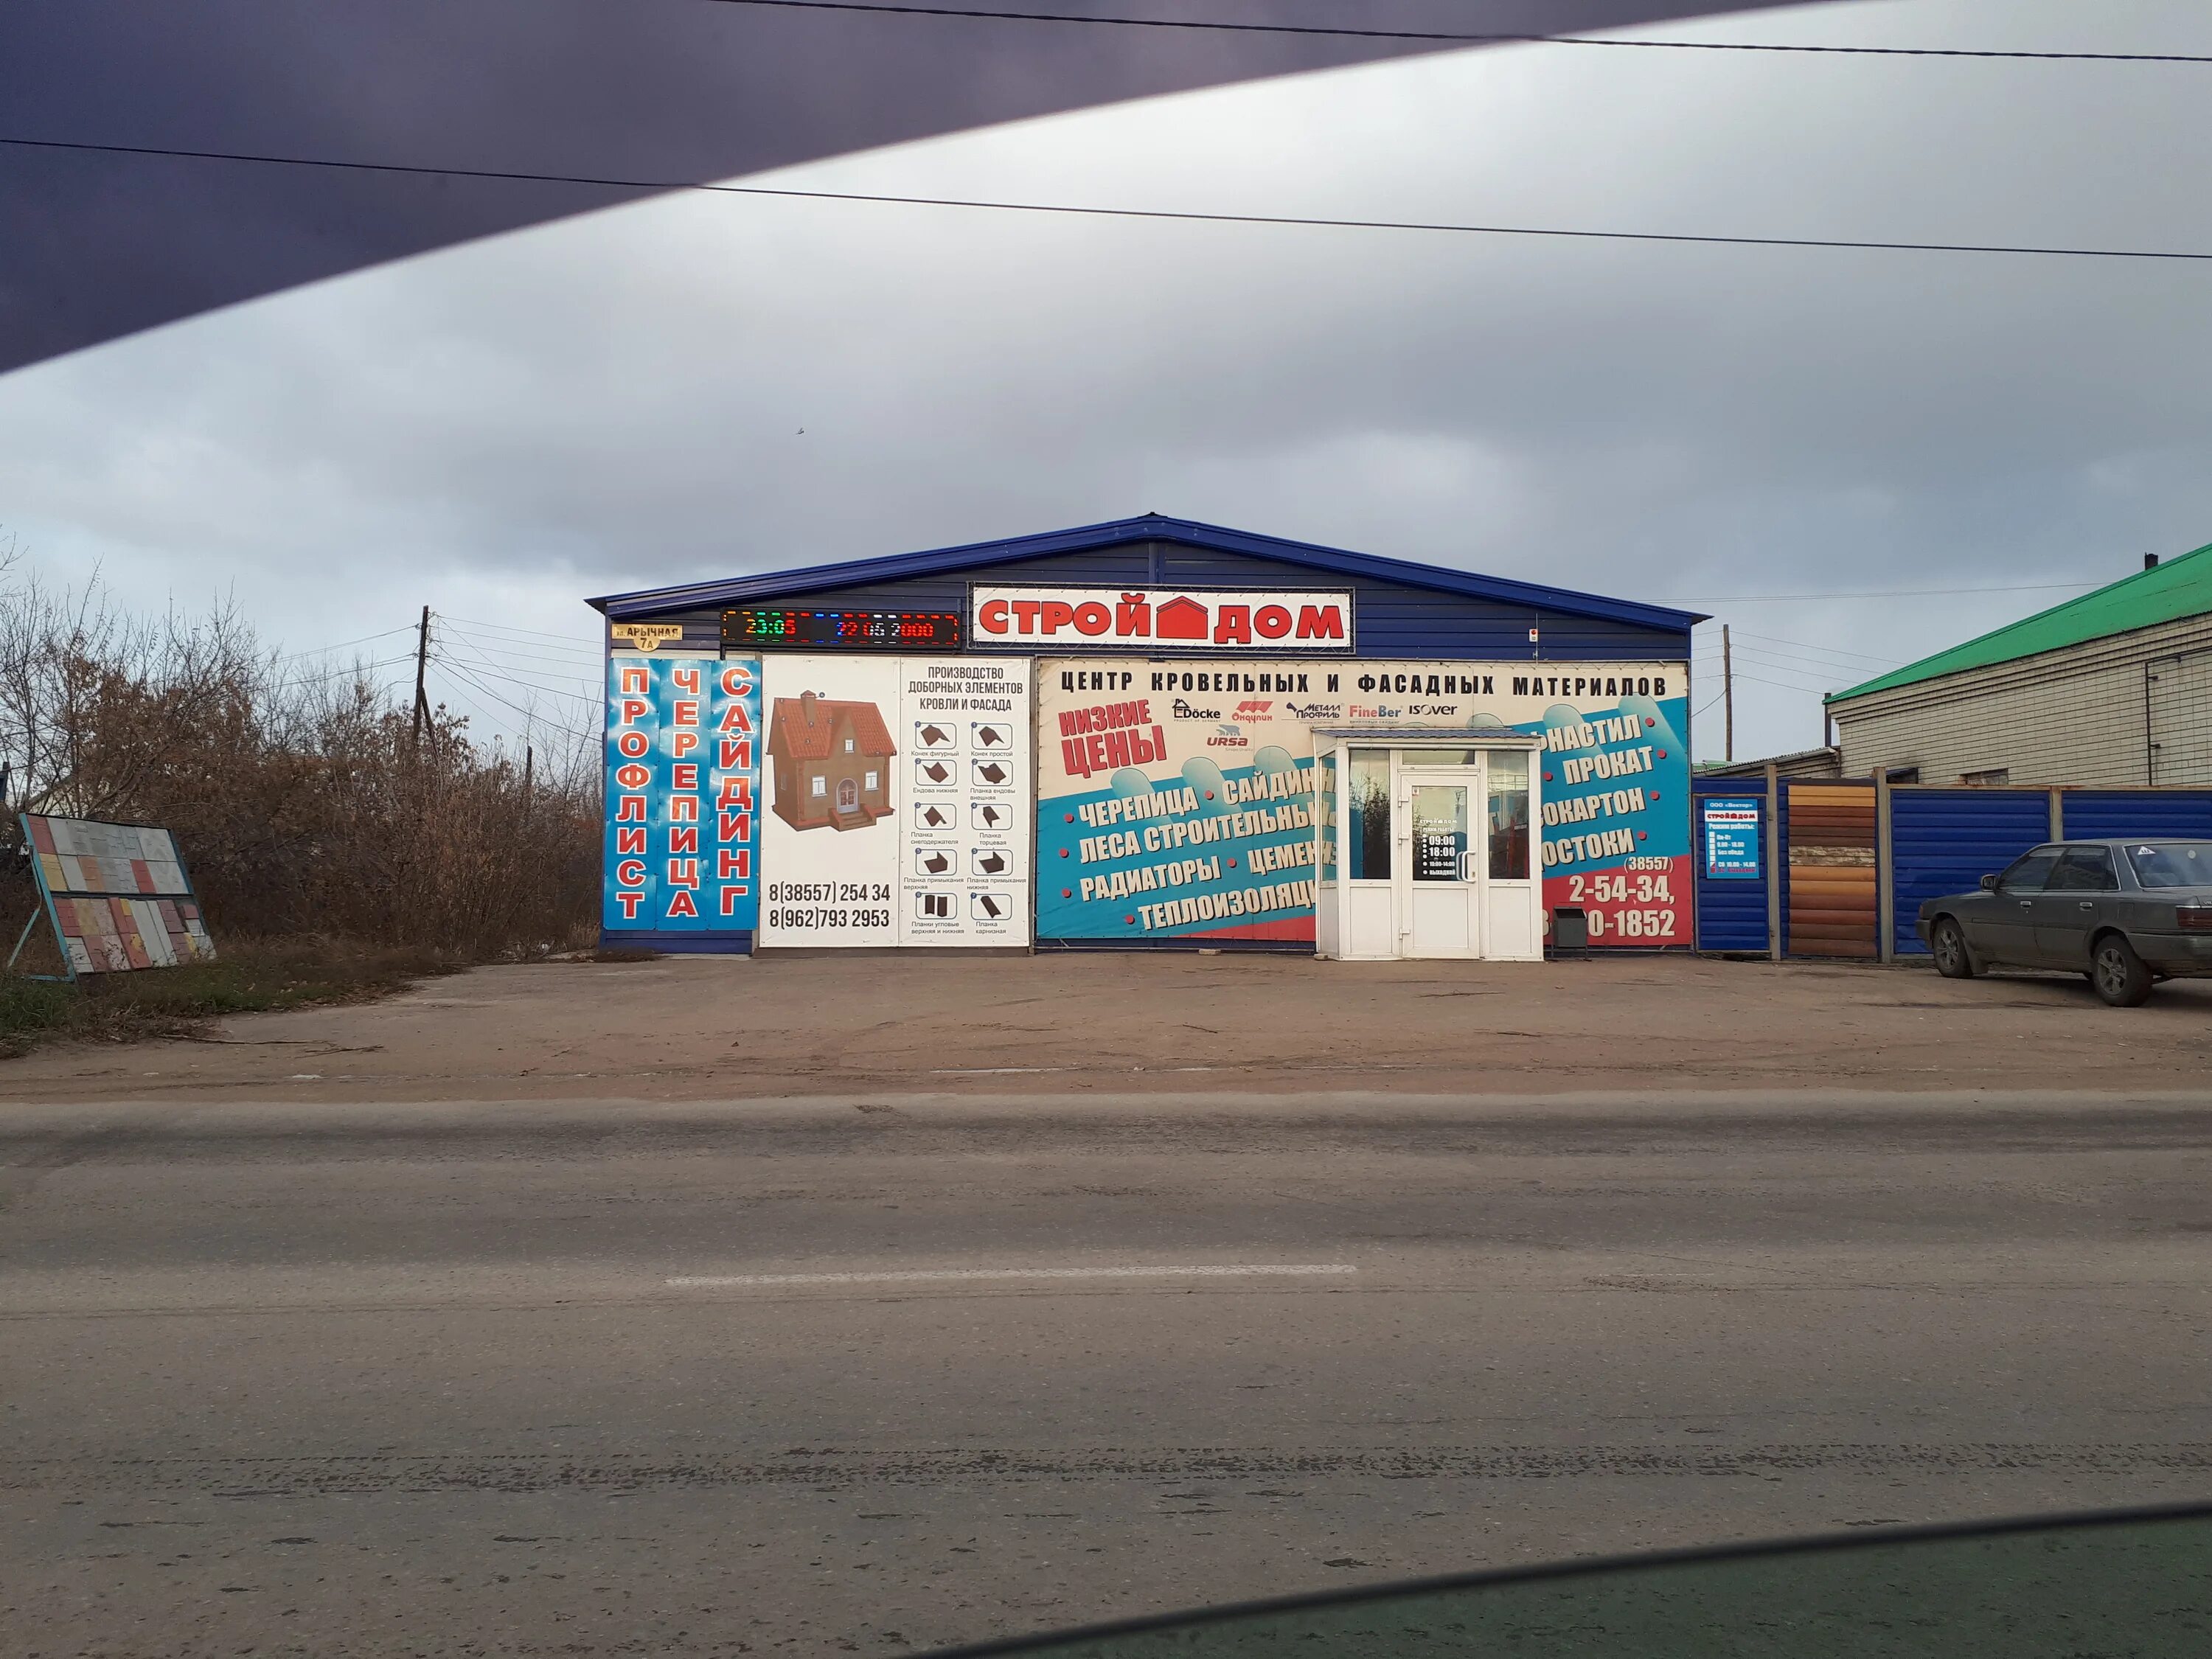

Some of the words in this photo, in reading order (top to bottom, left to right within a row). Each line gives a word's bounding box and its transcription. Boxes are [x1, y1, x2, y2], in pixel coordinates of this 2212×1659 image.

[627, 627, 678, 637] АРЫЧНАЯ
[745, 619, 796, 635] 23:05
[978, 592, 1152, 636] СТРОЙ
[1214, 604, 1344, 644] ДОМ
[640, 637, 653, 649] 7А
[908, 681, 963, 694] ДОБОРНЫХ
[964, 682, 1023, 695] ЭЛЕМЕНТОВ
[928, 666, 1004, 681] ПРОИЗВОДСТВО
[1062, 671, 1133, 693] ЦЕНТР
[1151, 672, 1310, 693] КРОВЕЛЬНЫХ
[1327, 673, 1339, 692] И
[1357, 674, 1494, 698] ФАСАДНЫХ
[1513, 677, 1666, 697] МАТЕРИАЛОВ
[919, 698, 959, 710] КРОВЛИ
[961, 698, 968, 710] И
[970, 698, 1012, 712] ФАСАДА
[1058, 699, 1152, 737] НИЗКИЕ
[1183, 708, 1221, 719] Döcke
[1349, 705, 1402, 718] FineBer
[1531, 714, 1643, 754] НАСТИЛ
[1061, 725, 1167, 779] ЦЕНЫ
[1562, 745, 1654, 785] ПРОКАТ
[615, 667, 651, 919] ПРОФЛИСТ
[666, 668, 700, 918] ЧЕРЕПИЦА
[715, 667, 755, 917] САЙДИНГ
[1078, 786, 1200, 828] ЧЕРЕПИЦА
[1221, 768, 1315, 805] САЙДИН
[1540, 787, 1646, 827] ОКАРТОН
[1079, 830, 1142, 864] ЛЕСА
[1144, 801, 1315, 852] СТРОИТЕЛЬНЫ
[1429, 835, 1455, 846] 09:00
[1429, 846, 1455, 857] 18:00
[1541, 827, 1636, 871] ОСТОКИ
[1079, 855, 1222, 902] РАДИАТОРЫ
[1248, 840, 1315, 876] ЦЕМЕН
[1624, 856, 1674, 874] (38557)
[769, 880, 836, 904] 8(38557)
[840, 884, 869, 901] 254
[872, 884, 891, 901] 34
[1568, 874, 1675, 905] 2-54-34,
[770, 906, 847, 930] 8(962)793
[852, 909, 890, 928] 2953
